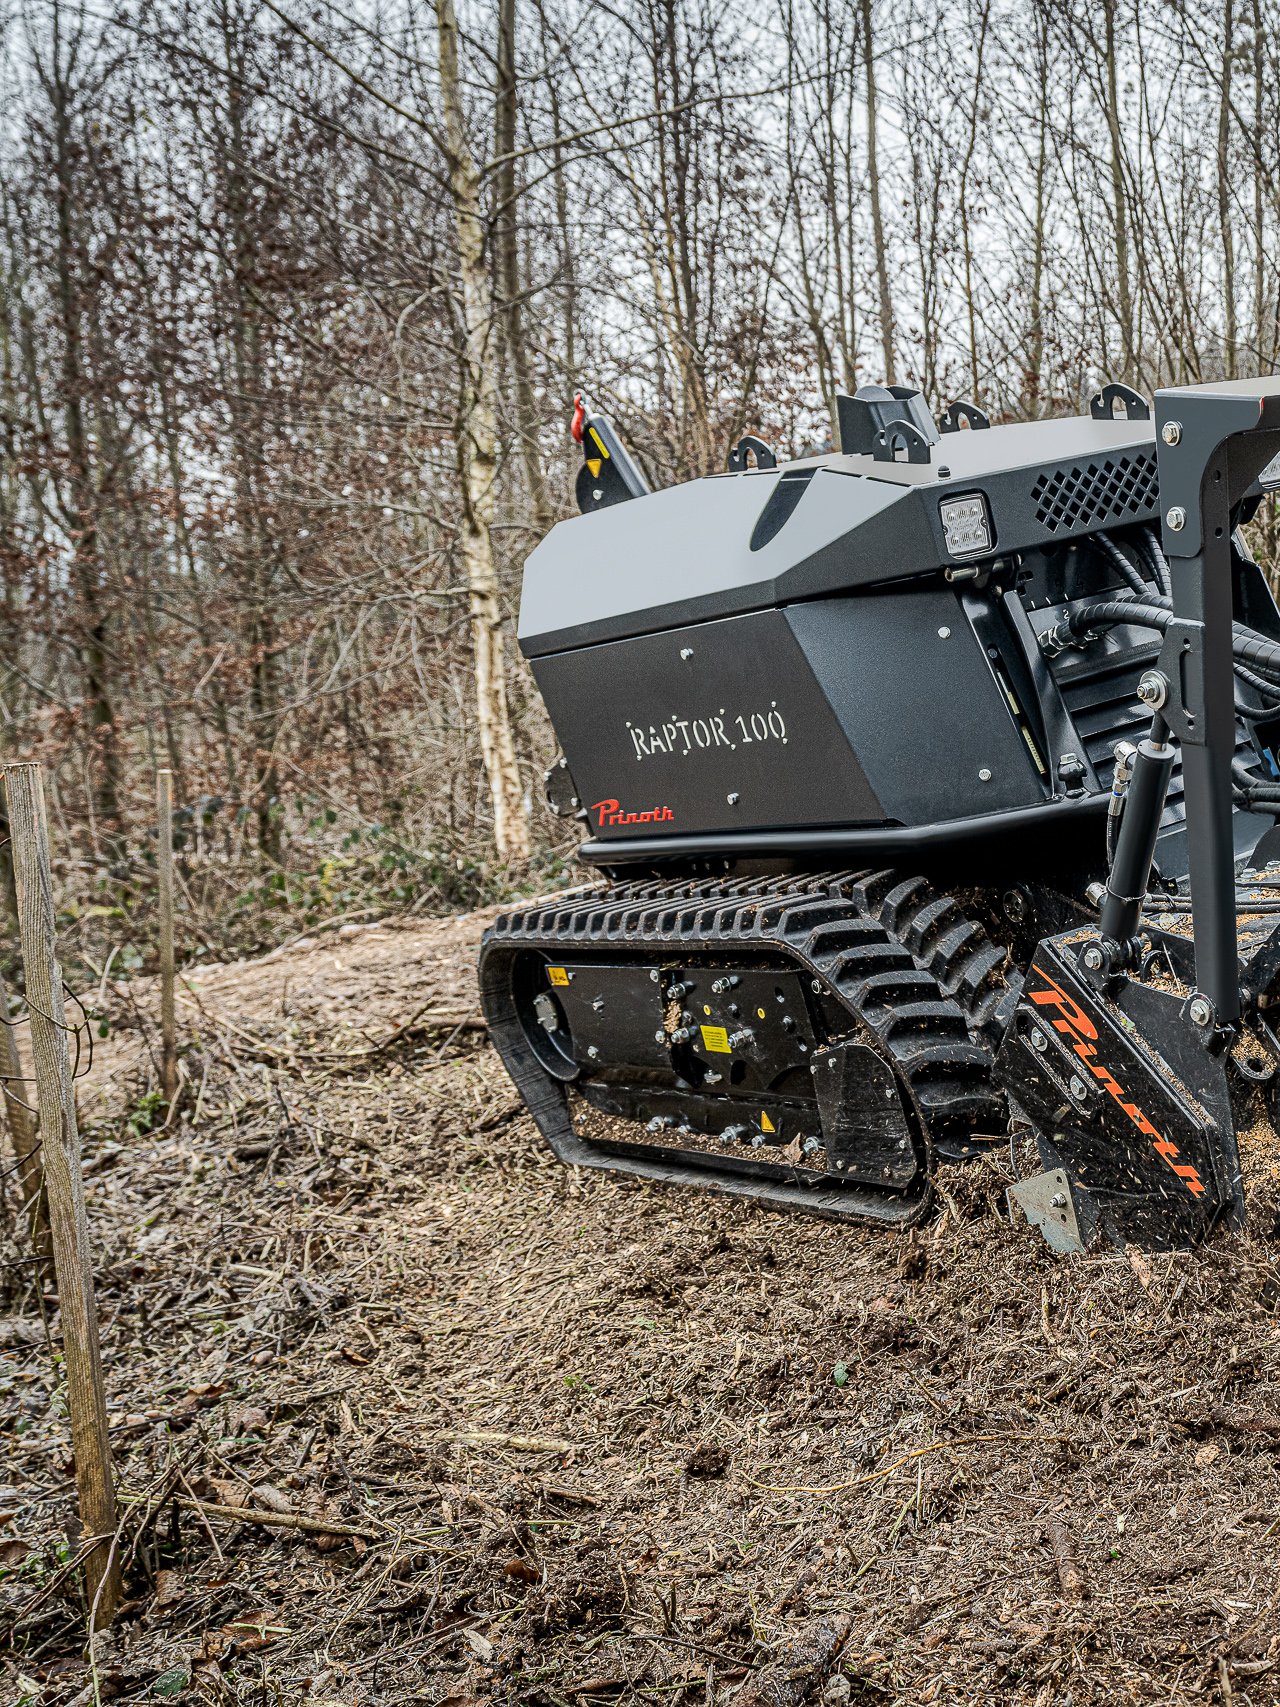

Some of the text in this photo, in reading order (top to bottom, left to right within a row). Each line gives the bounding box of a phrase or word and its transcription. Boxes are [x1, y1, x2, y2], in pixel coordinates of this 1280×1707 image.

[630, 710, 786, 756] RAPTOR 100
[591, 798, 675, 827] Prinoth
[1028, 963, 1206, 1199] Prinoth
